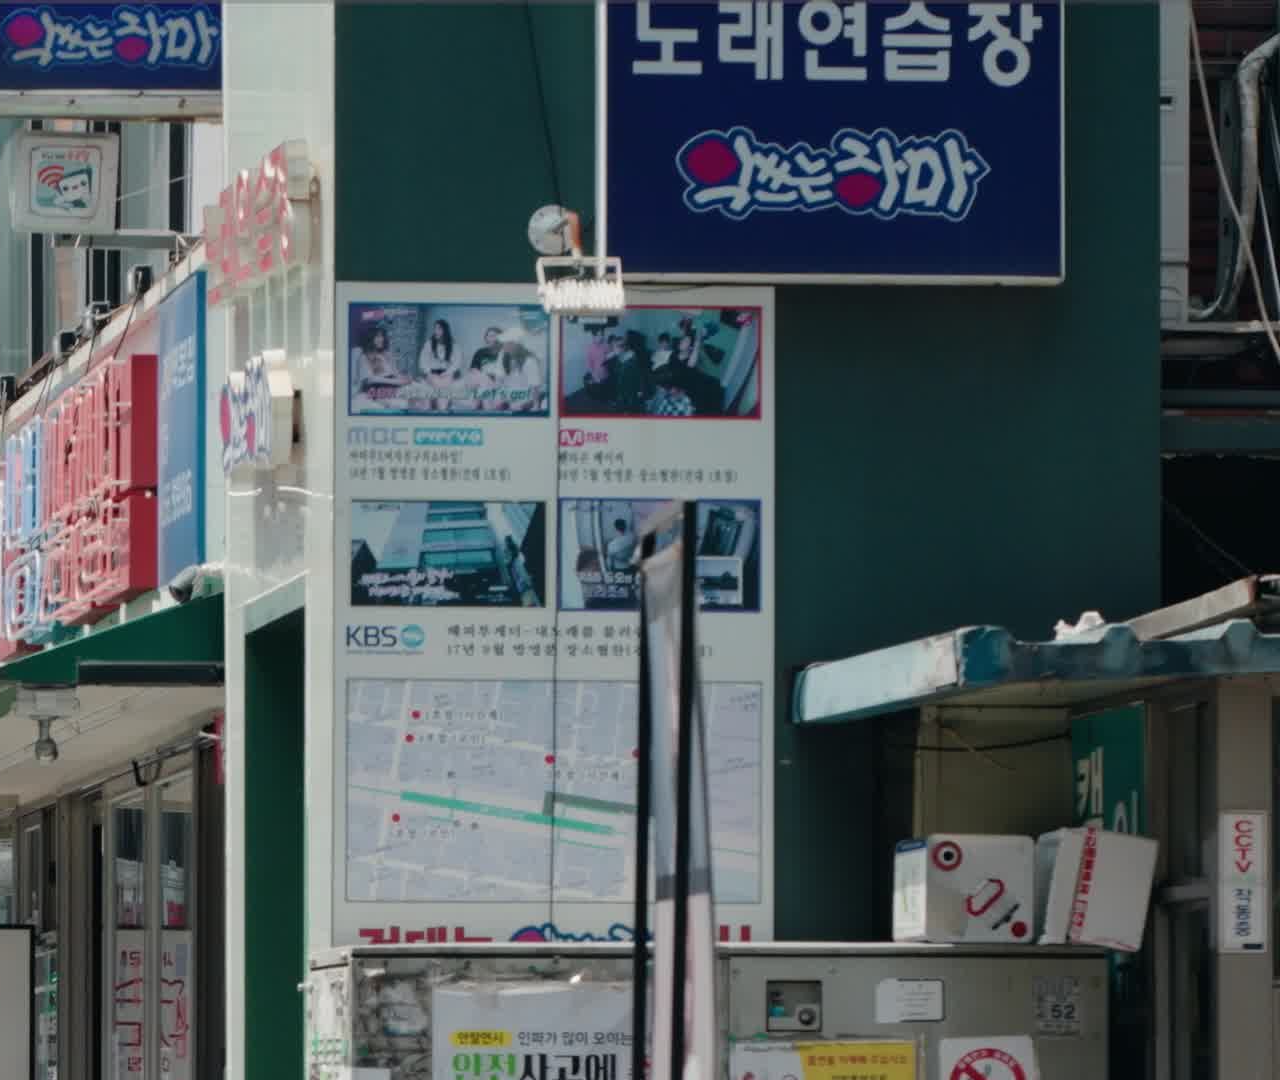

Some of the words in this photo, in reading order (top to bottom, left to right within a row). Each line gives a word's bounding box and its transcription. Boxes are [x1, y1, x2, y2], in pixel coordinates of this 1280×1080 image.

[345, 624, 398, 648] KBS
[1233, 819, 1254, 874] CCTV
[1051, 1004, 1076, 1020] 52
